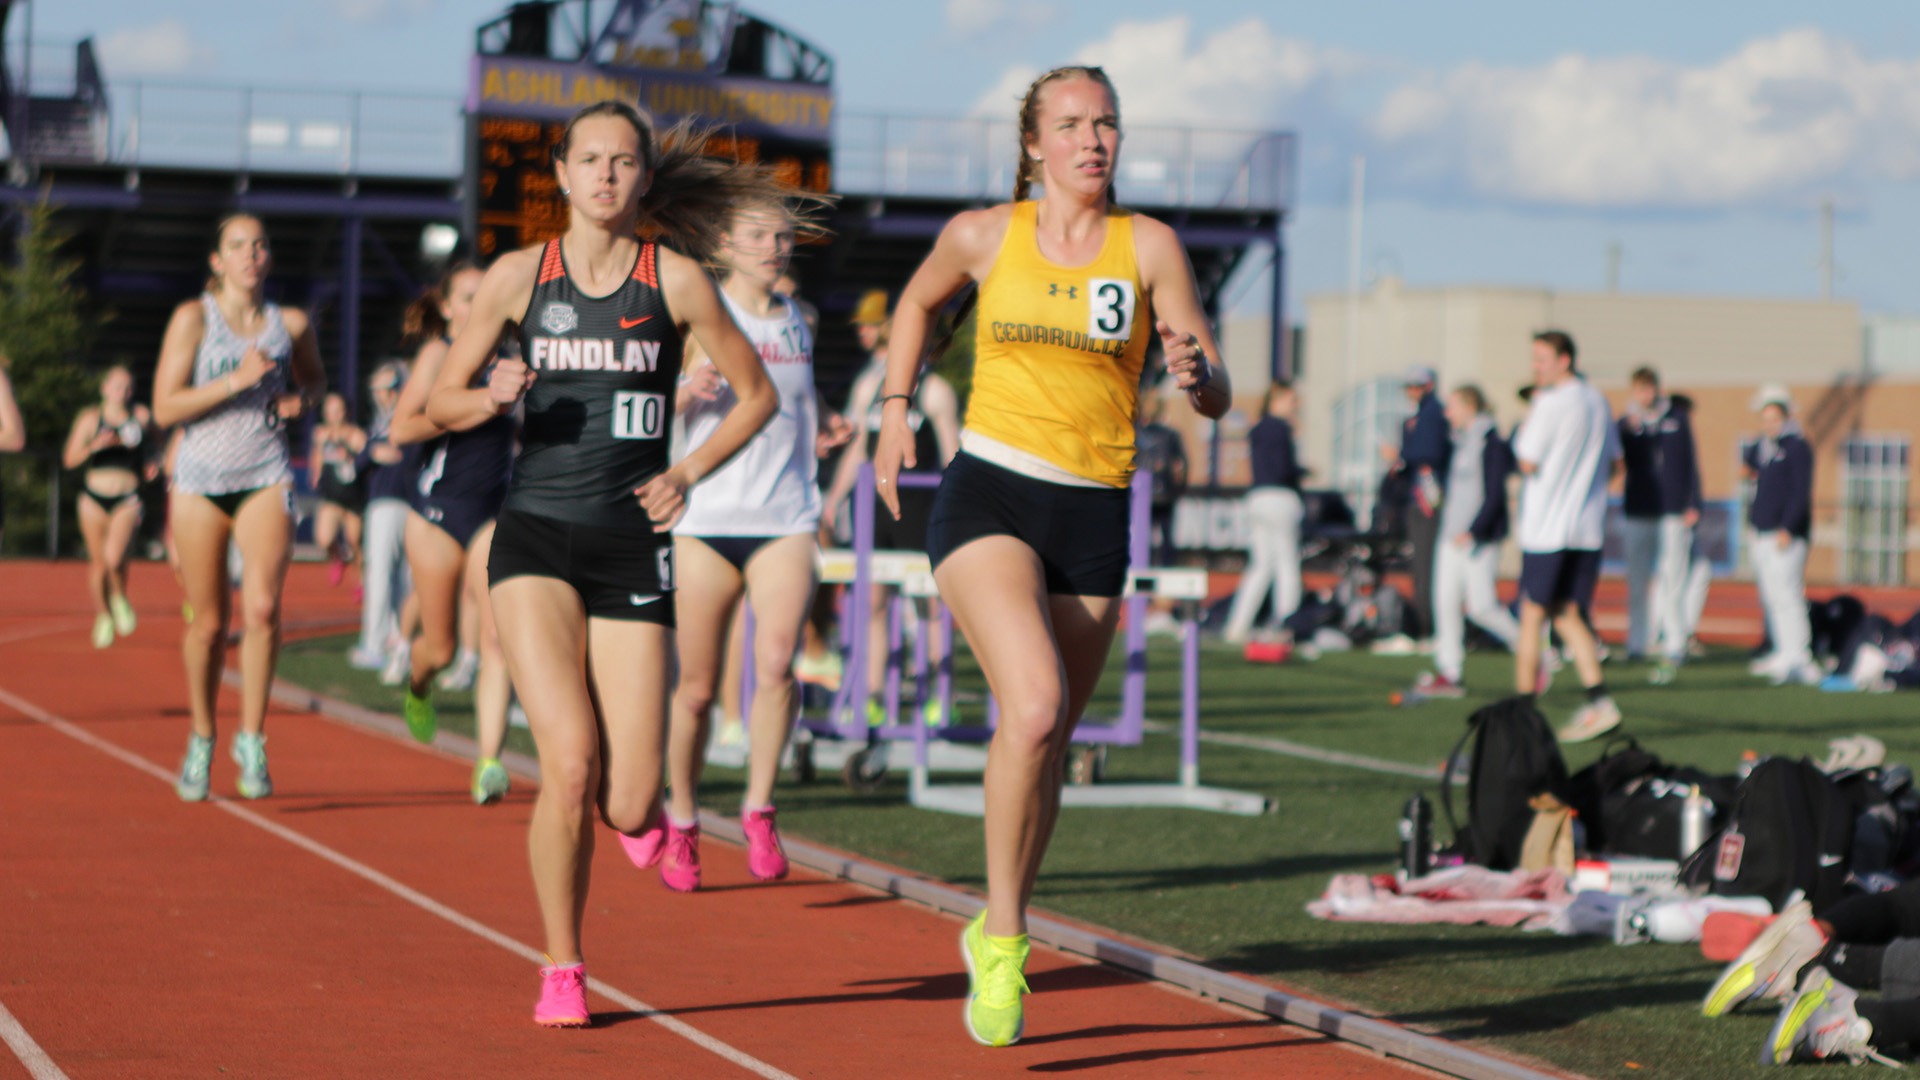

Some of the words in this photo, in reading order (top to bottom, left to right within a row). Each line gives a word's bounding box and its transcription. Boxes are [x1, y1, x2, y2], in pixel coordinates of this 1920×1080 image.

[651, 83, 833, 128] UNIVERSITY
[1097, 283, 1125, 334] 3
[530, 337, 661, 372] FINDLAY
[621, 396, 659, 436] 10
